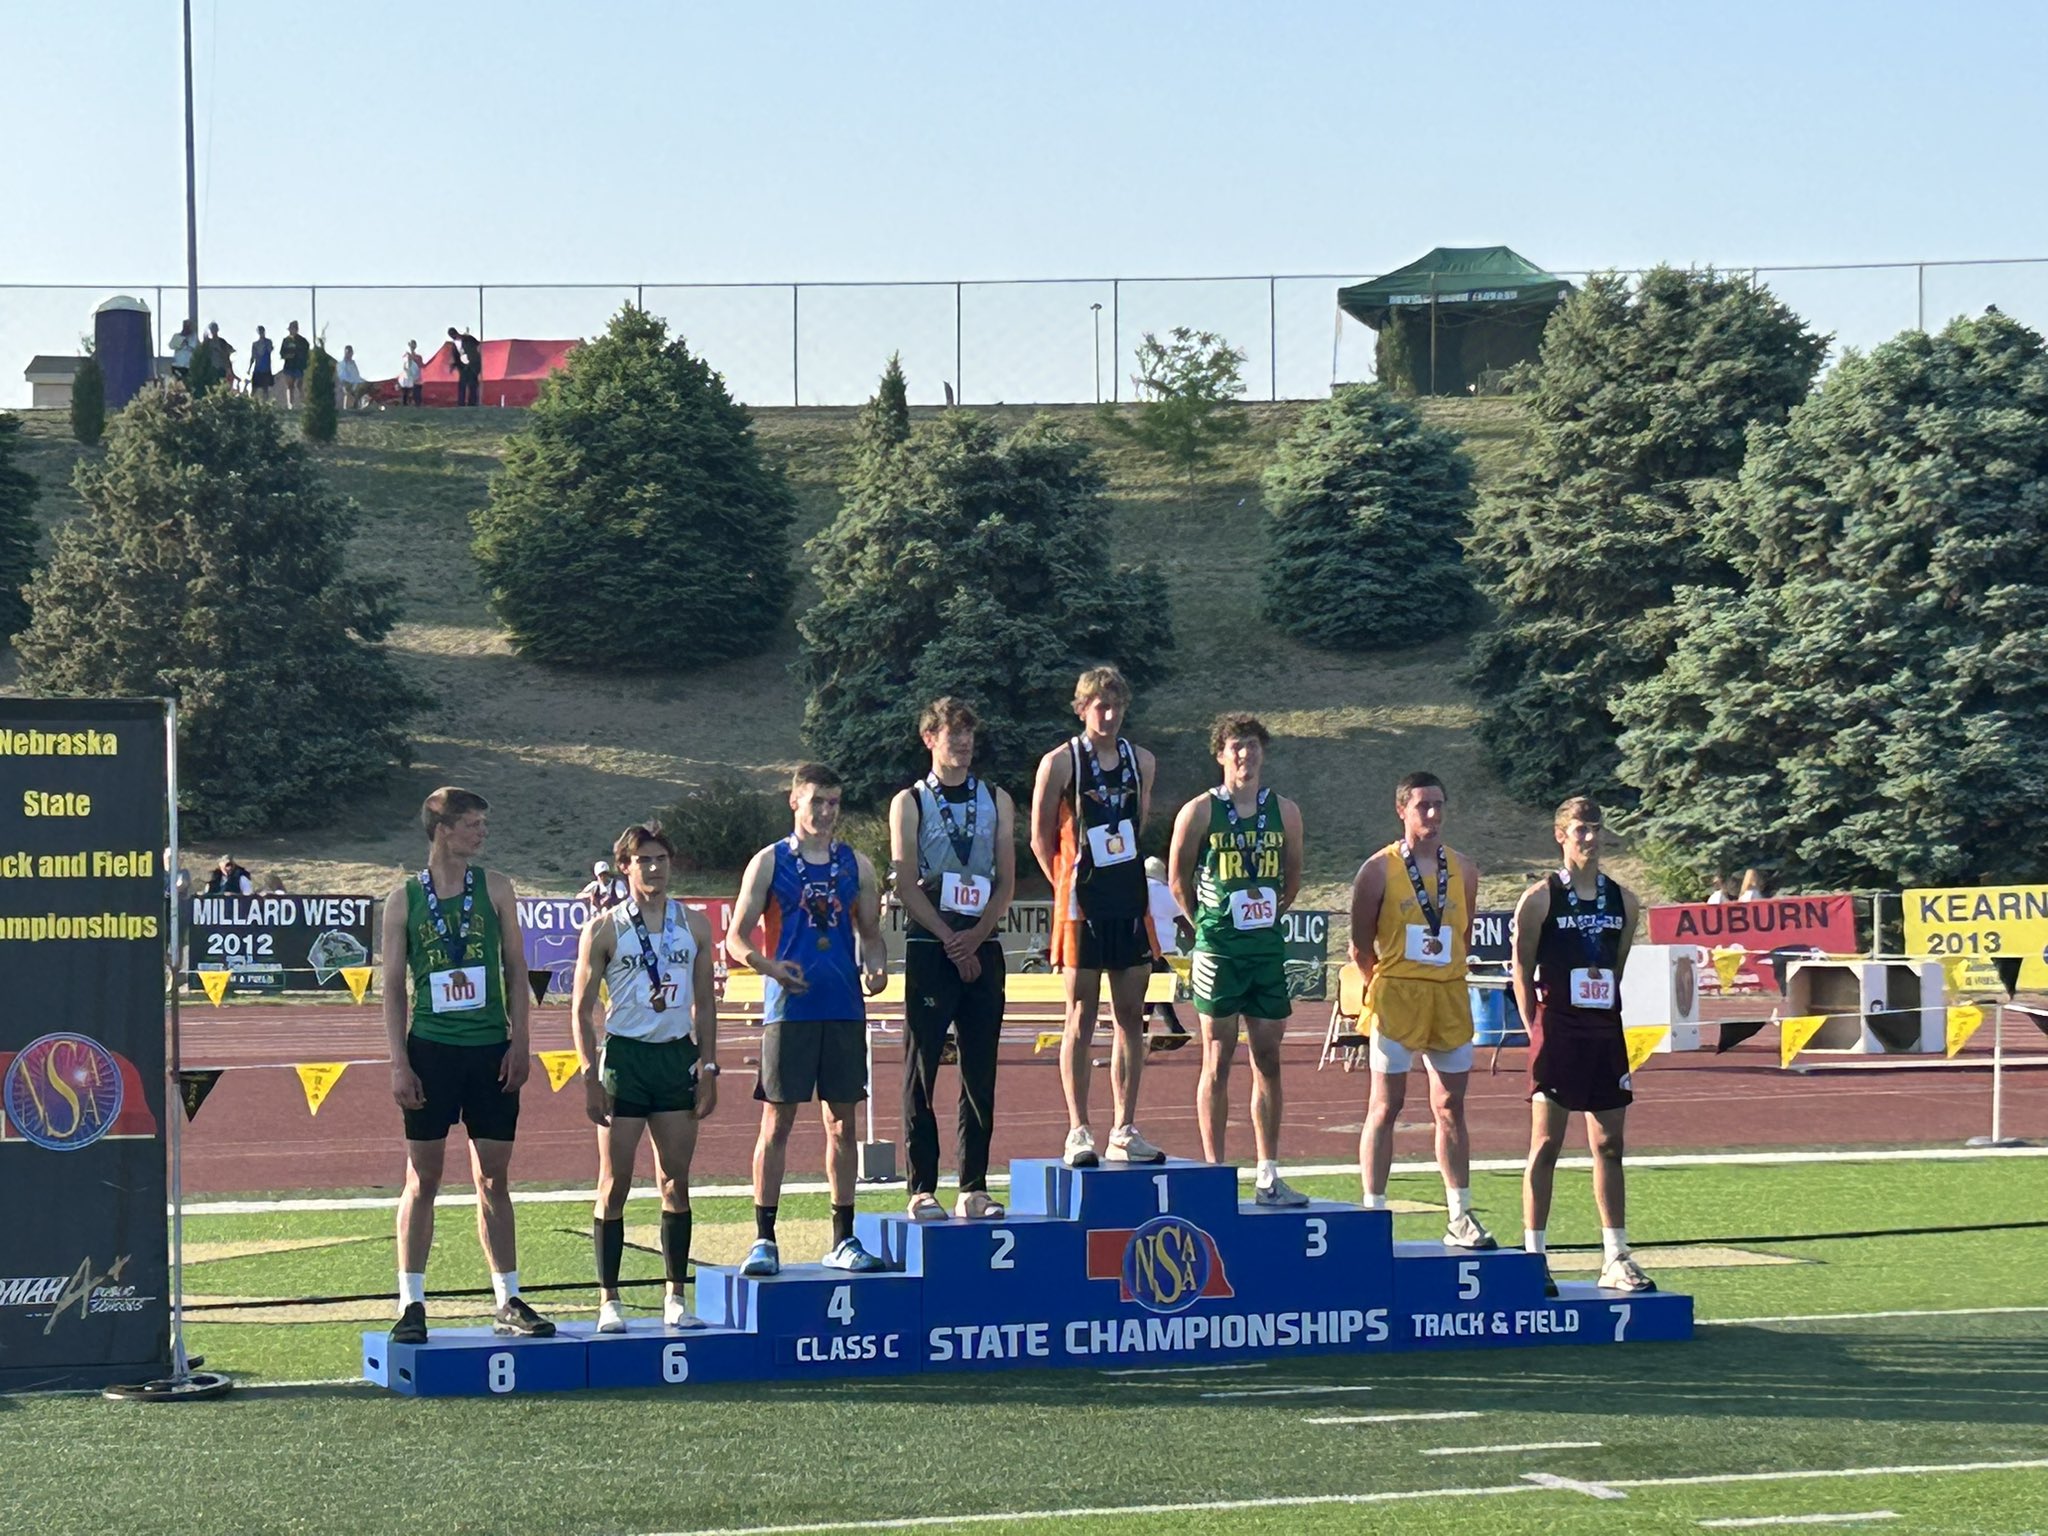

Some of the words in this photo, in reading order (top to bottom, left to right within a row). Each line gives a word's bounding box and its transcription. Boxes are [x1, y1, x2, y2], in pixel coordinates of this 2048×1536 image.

[0, 729, 118, 756] Nebraska
[23, 790, 91, 817] State
[0, 851, 34, 878] ck
[38, 852, 87, 878] and
[92, 851, 153, 878] Field
[1219, 850, 1279, 880] IRSH
[954, 886, 980, 906] 103
[1920, 892, 2048, 924] KEARN
[193, 898, 296, 926] MILLARD
[302, 898, 370, 926] WEST
[1241, 901, 1273, 922] 205
[1676, 902, 1829, 937] AUBURN
[207, 933, 273, 955] 2012
[1927, 931, 2002, 954] 2013
[442, 982, 475, 1002] 100
[1153, 1174, 1169, 1213] 1
[990, 1230, 1015, 1269] 2
[1306, 1218, 1328, 1257] 3
[1458, 1261, 1480, 1299] 5
[827, 1285, 855, 1325] 4
[929, 1322, 1049, 1361] STATE
[1065, 1308, 1389, 1354] CHAMPIONSHIPS
[1411, 1312, 1484, 1337] TRACK
[1491, 1312, 1508, 1334] &
[1515, 1309, 1579, 1334] FIELD
[1609, 1304, 1631, 1341] 7
[796, 1334, 877, 1361] CLASS
[884, 1334, 899, 1358] C
[488, 1352, 515, 1392] 8
[662, 1343, 688, 1383] 6
